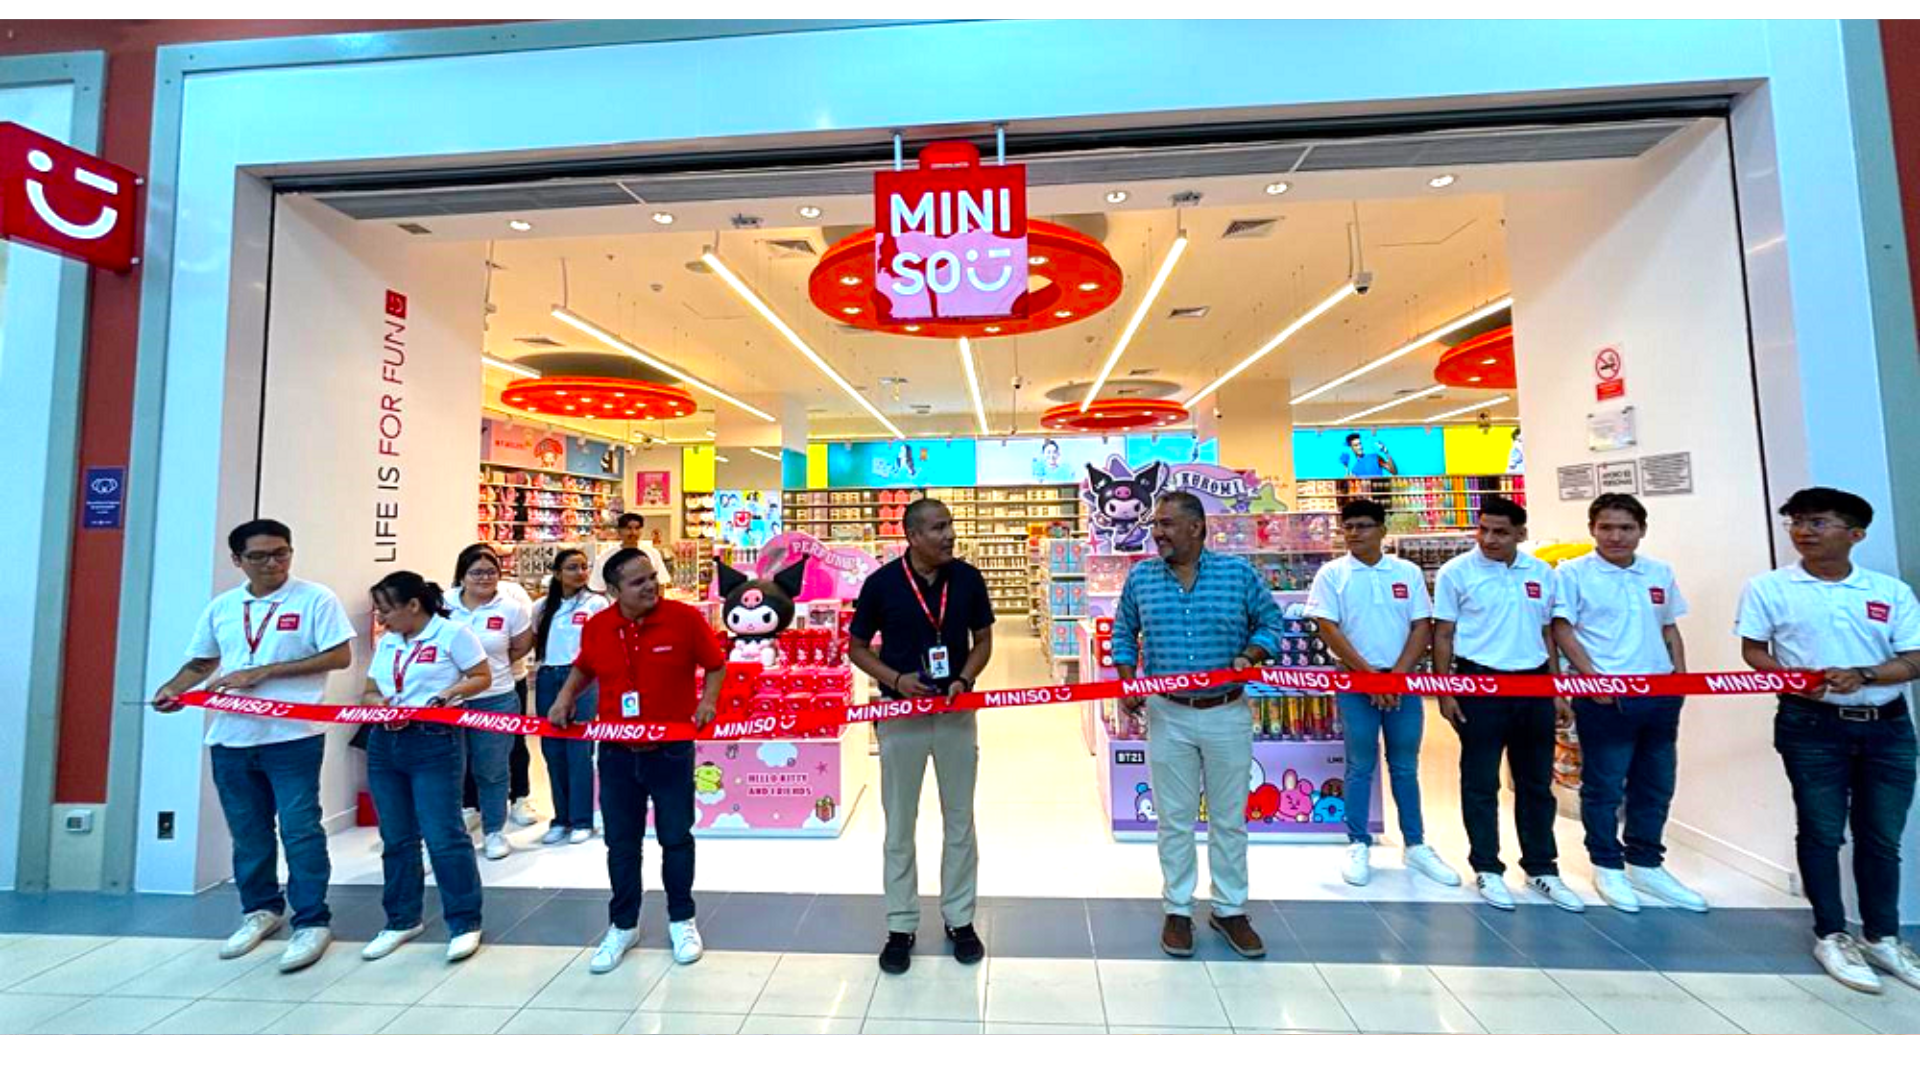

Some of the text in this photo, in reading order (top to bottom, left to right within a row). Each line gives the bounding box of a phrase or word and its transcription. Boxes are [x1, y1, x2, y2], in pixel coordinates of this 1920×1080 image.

[890, 188, 1011, 238] MINI
[374, 320, 406, 562] LIFE IS FOR FUN
[1181, 472, 1240, 495] KUROMI
[1122, 675, 1190, 695] MINISO
[1260, 669, 1330, 689] MINISO
[1405, 675, 1477, 694] MINISO
[1553, 677, 1627, 694] MINISO
[1705, 675, 1784, 693] MINISO
[203, 694, 273, 716] MINISO
[984, 689, 1051, 706] MINISO
[335, 706, 399, 723] MINISO
[457, 711, 521, 732] MINISO
[846, 702, 912, 722] MINISO
[583, 724, 645, 740] MINISO
[713, 716, 777, 739] MINISO
[1118, 752, 1144, 763] BT21
[748, 787, 769, 796] AND
